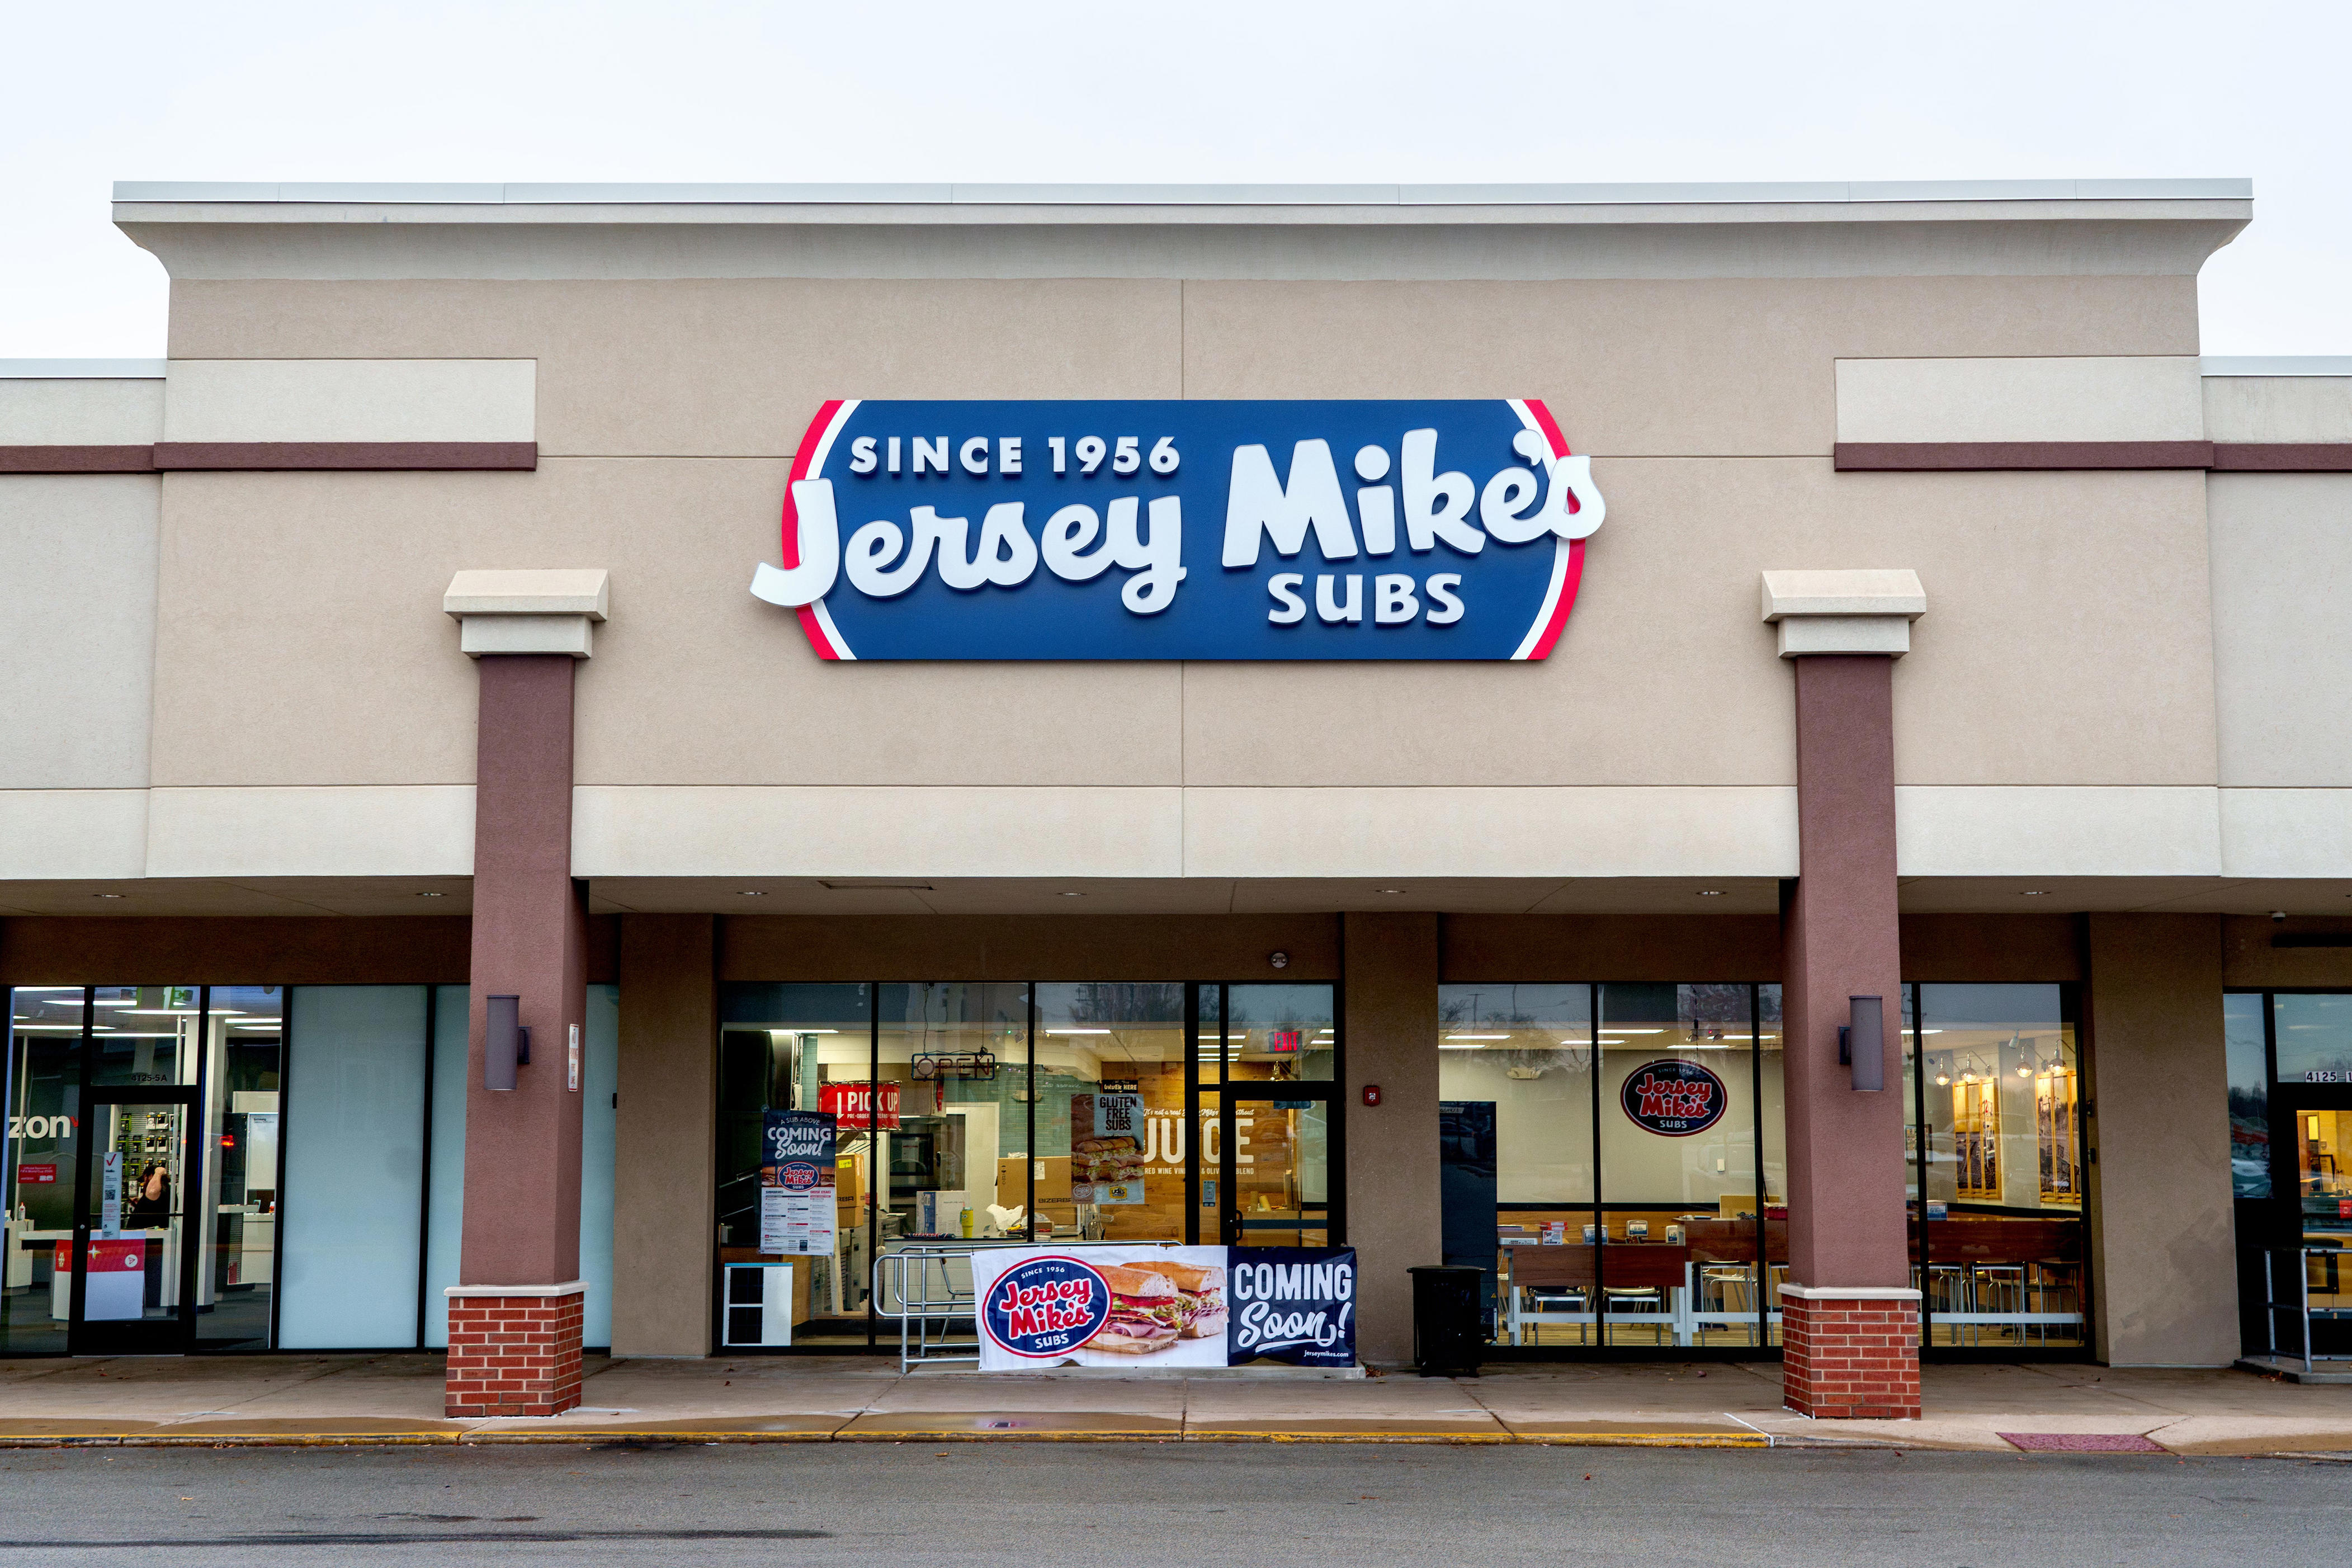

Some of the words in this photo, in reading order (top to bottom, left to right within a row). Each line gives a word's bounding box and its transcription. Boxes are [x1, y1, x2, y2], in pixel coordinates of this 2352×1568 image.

[849, 436, 1022, 474] SINCE
[1048, 436, 1180, 474] 1956
[749, 478, 1187, 615] Jersey
[1222, 428, 1607, 568] Mike's
[1268, 573, 1465, 624] SUBS
[1274, 1032, 1298, 1051] EXIT
[917, 1057, 990, 1077] OPEN
[1636, 1073, 1712, 1103] Jersey
[887, 1092, 898, 1112] UP
[1099, 1097, 1137, 1108] GLUTEN
[1639, 1094, 1711, 1119] Mike's
[800, 1117, 821, 1126] ABOVE
[1106, 1108, 1131, 1119] FREE
[767, 1127, 832, 1141] COMING
[1106, 1119, 1132, 1131] SUBS
[1659, 1120, 1688, 1128] SUBS
[774, 1139, 825, 1159] Soon!
[1144, 1118, 1254, 1164] JUCE
[783, 1167, 815, 1178] Jersey
[785, 1175, 814, 1185] Mike's
[1021, 1267, 1043, 1279] SINCE
[1235, 1263, 1352, 1301] COMING
[999, 1278, 1093, 1313] Jersey
[1008, 1300, 1094, 1340] Mike's
[1238, 1301, 1352, 1348] Soon!
[1035, 1333, 1070, 1349] SUBS
[1303, 1349, 1349, 1358] jerseymikes.com
